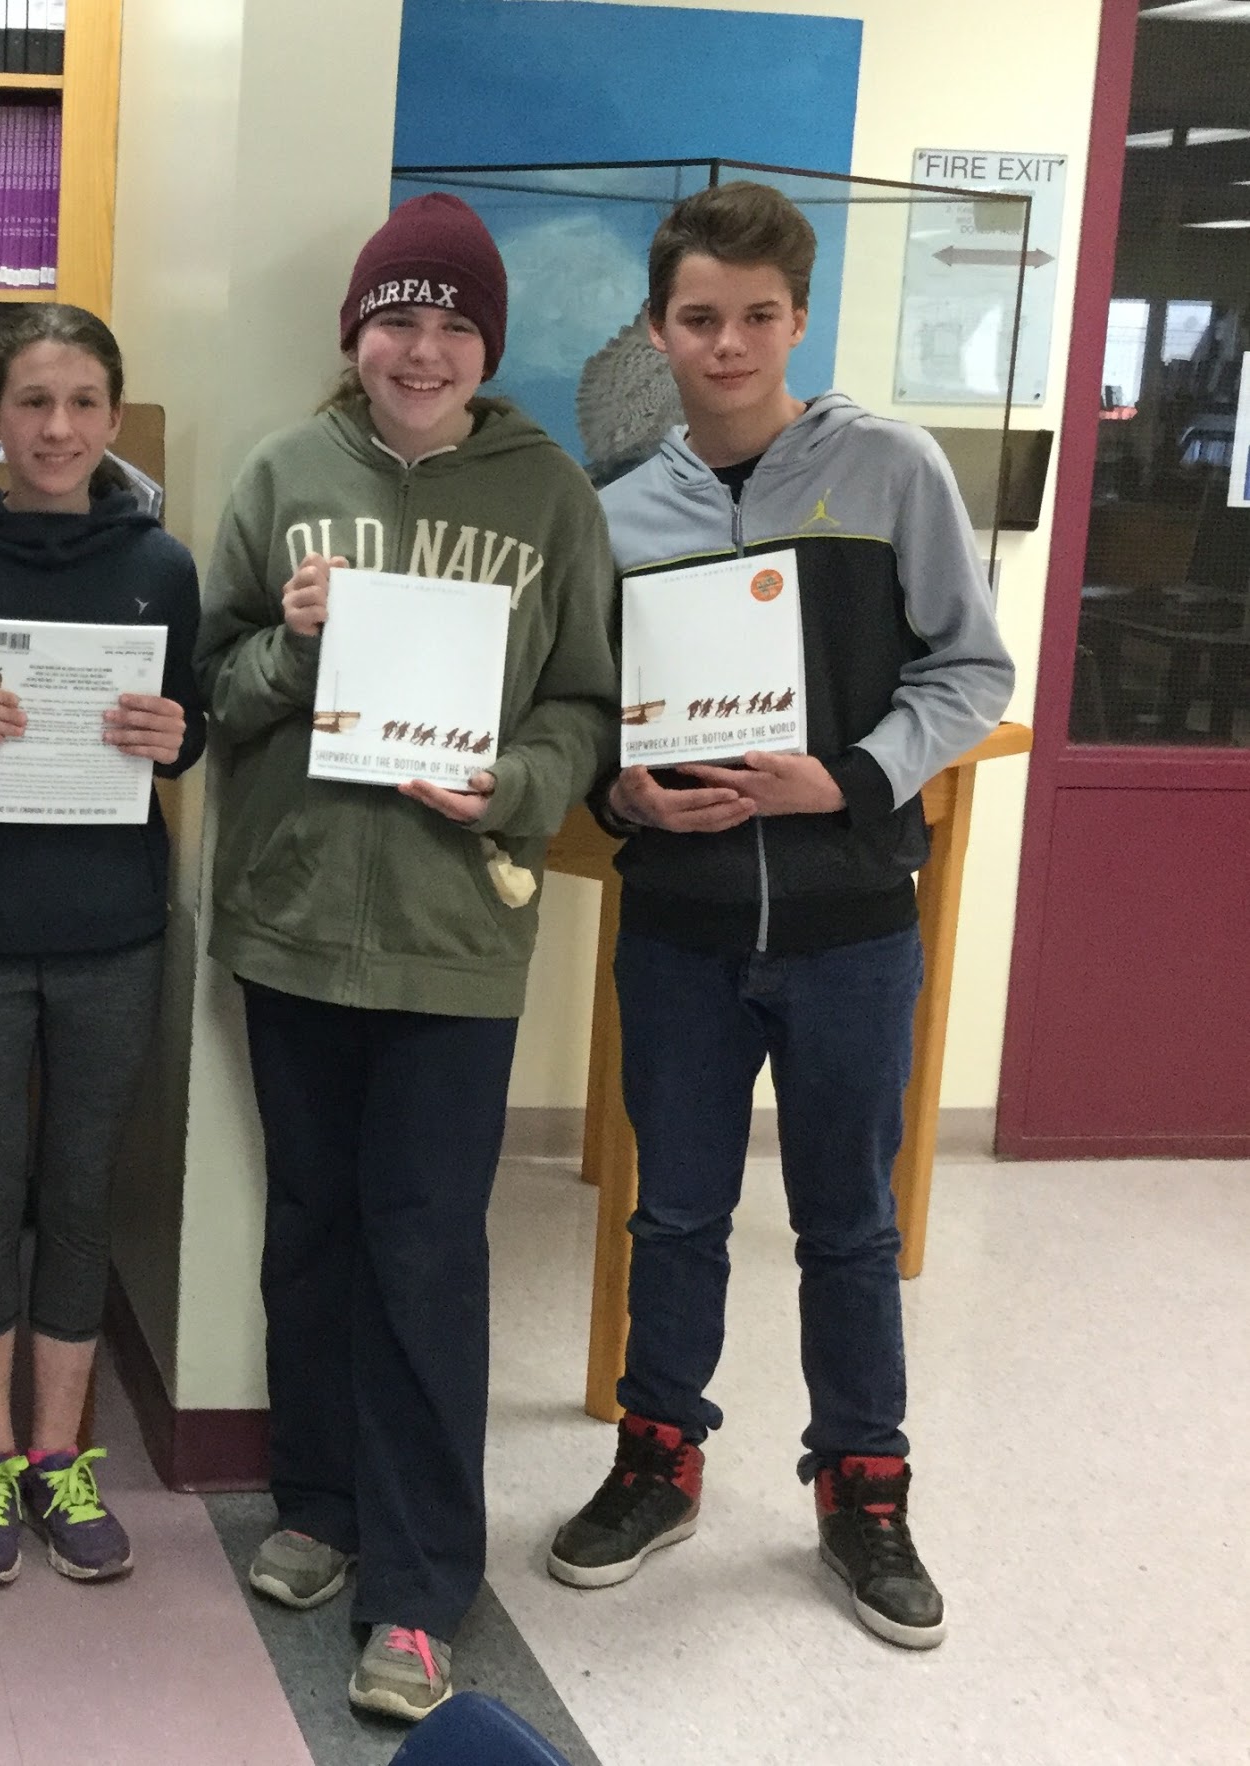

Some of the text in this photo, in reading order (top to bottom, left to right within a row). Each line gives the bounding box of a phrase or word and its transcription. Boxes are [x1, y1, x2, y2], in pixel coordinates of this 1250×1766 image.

[926, 155, 1060, 181] FIRE EXIT
[358, 278, 458, 319] FAIRFAX
[406, 518, 544, 610] NAVY
[626, 740, 669, 752] SHIPWRECK
[670, 738, 680, 748] AT
[684, 735, 698, 746] THE
[702, 731, 734, 744] BOTTOM
[737, 729, 748, 740] OF
[751, 726, 766, 737] THE
[769, 721, 796, 735] WORLD
[315, 750, 359, 765] SHIPWRECK
[362, 755, 372, 766] AT
[375, 756, 391, 768] THE
[394, 758, 427, 773] BOTTOM
[430, 761, 441, 773] OF
[445, 763, 459, 776] THE
